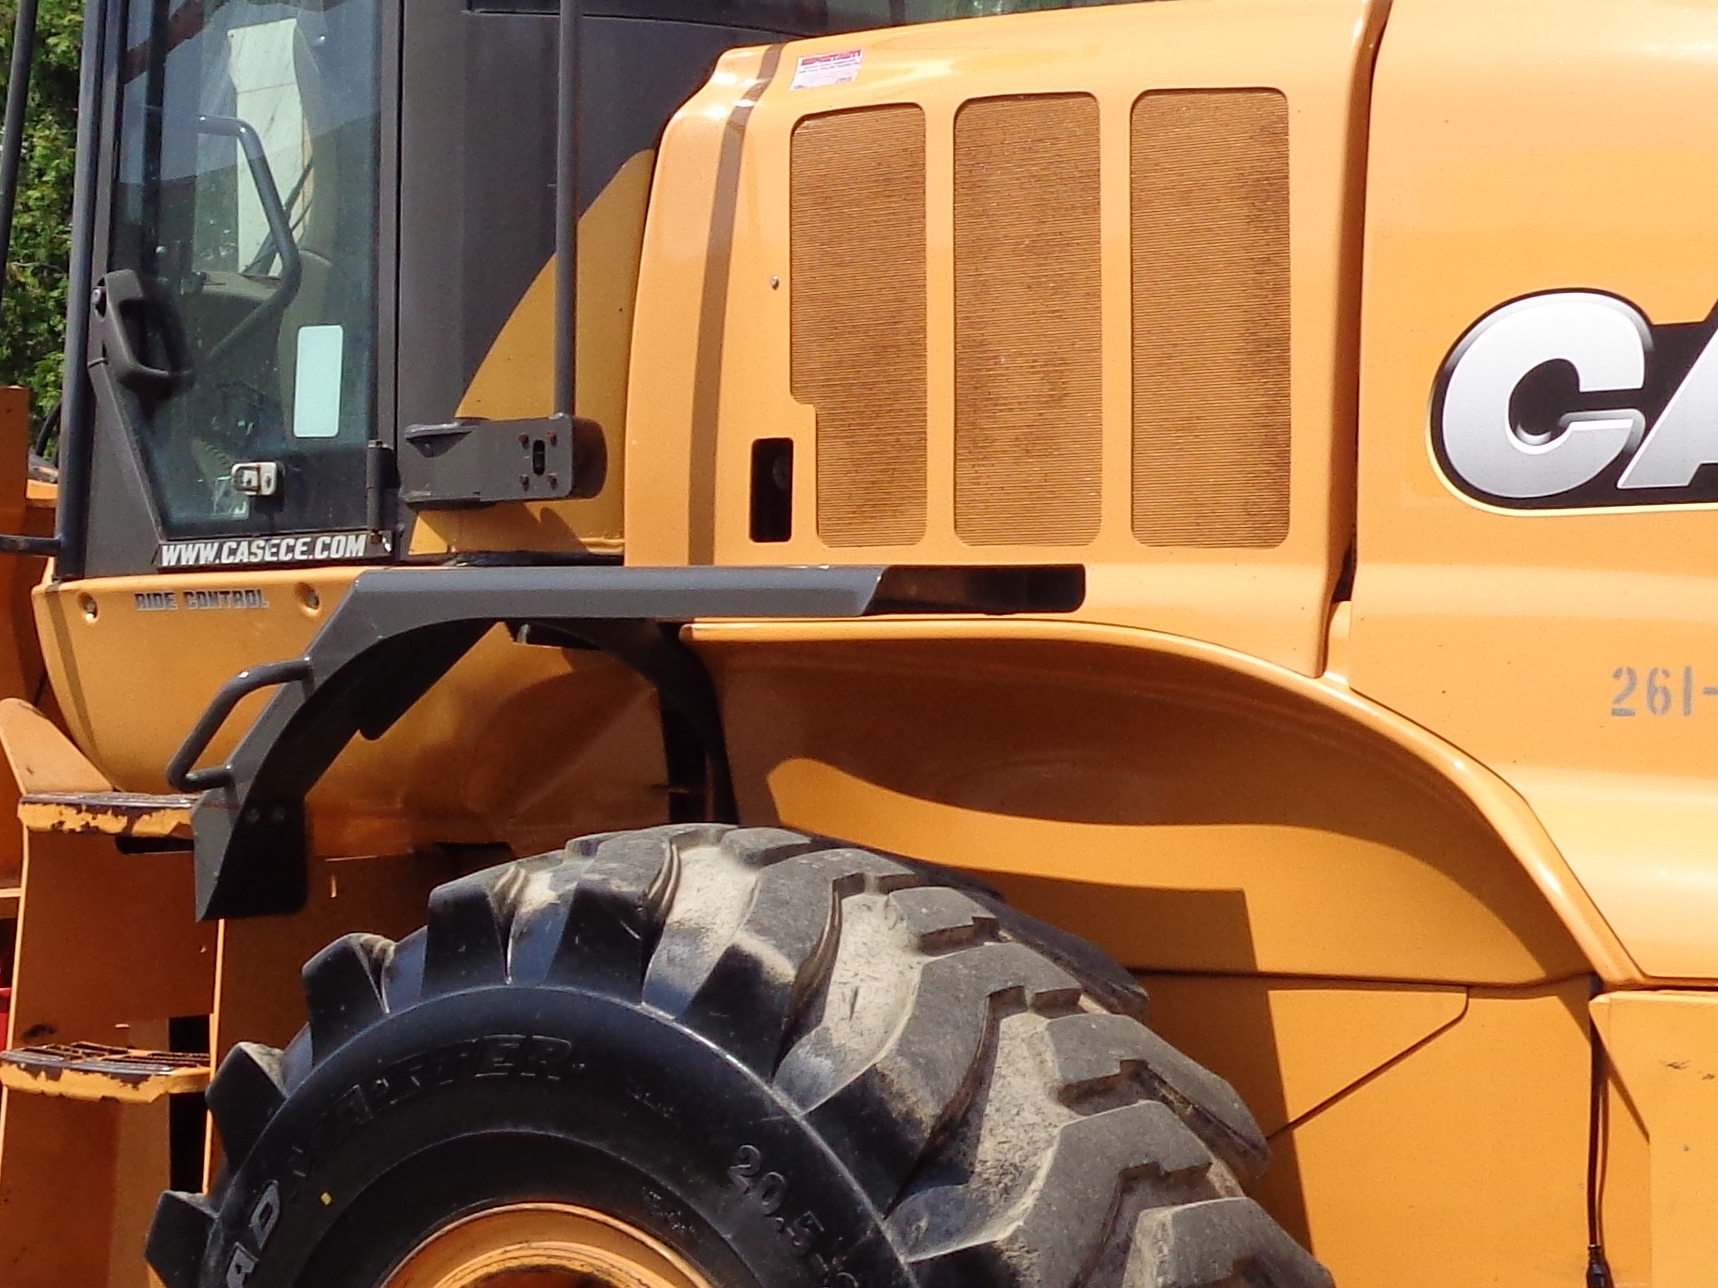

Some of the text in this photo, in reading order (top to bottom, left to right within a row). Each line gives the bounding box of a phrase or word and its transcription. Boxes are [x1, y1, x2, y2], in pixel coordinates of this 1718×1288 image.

[160, 533, 368, 568] WWW.CASECE.COM
[134, 588, 270, 612] RIDE CONTROL
